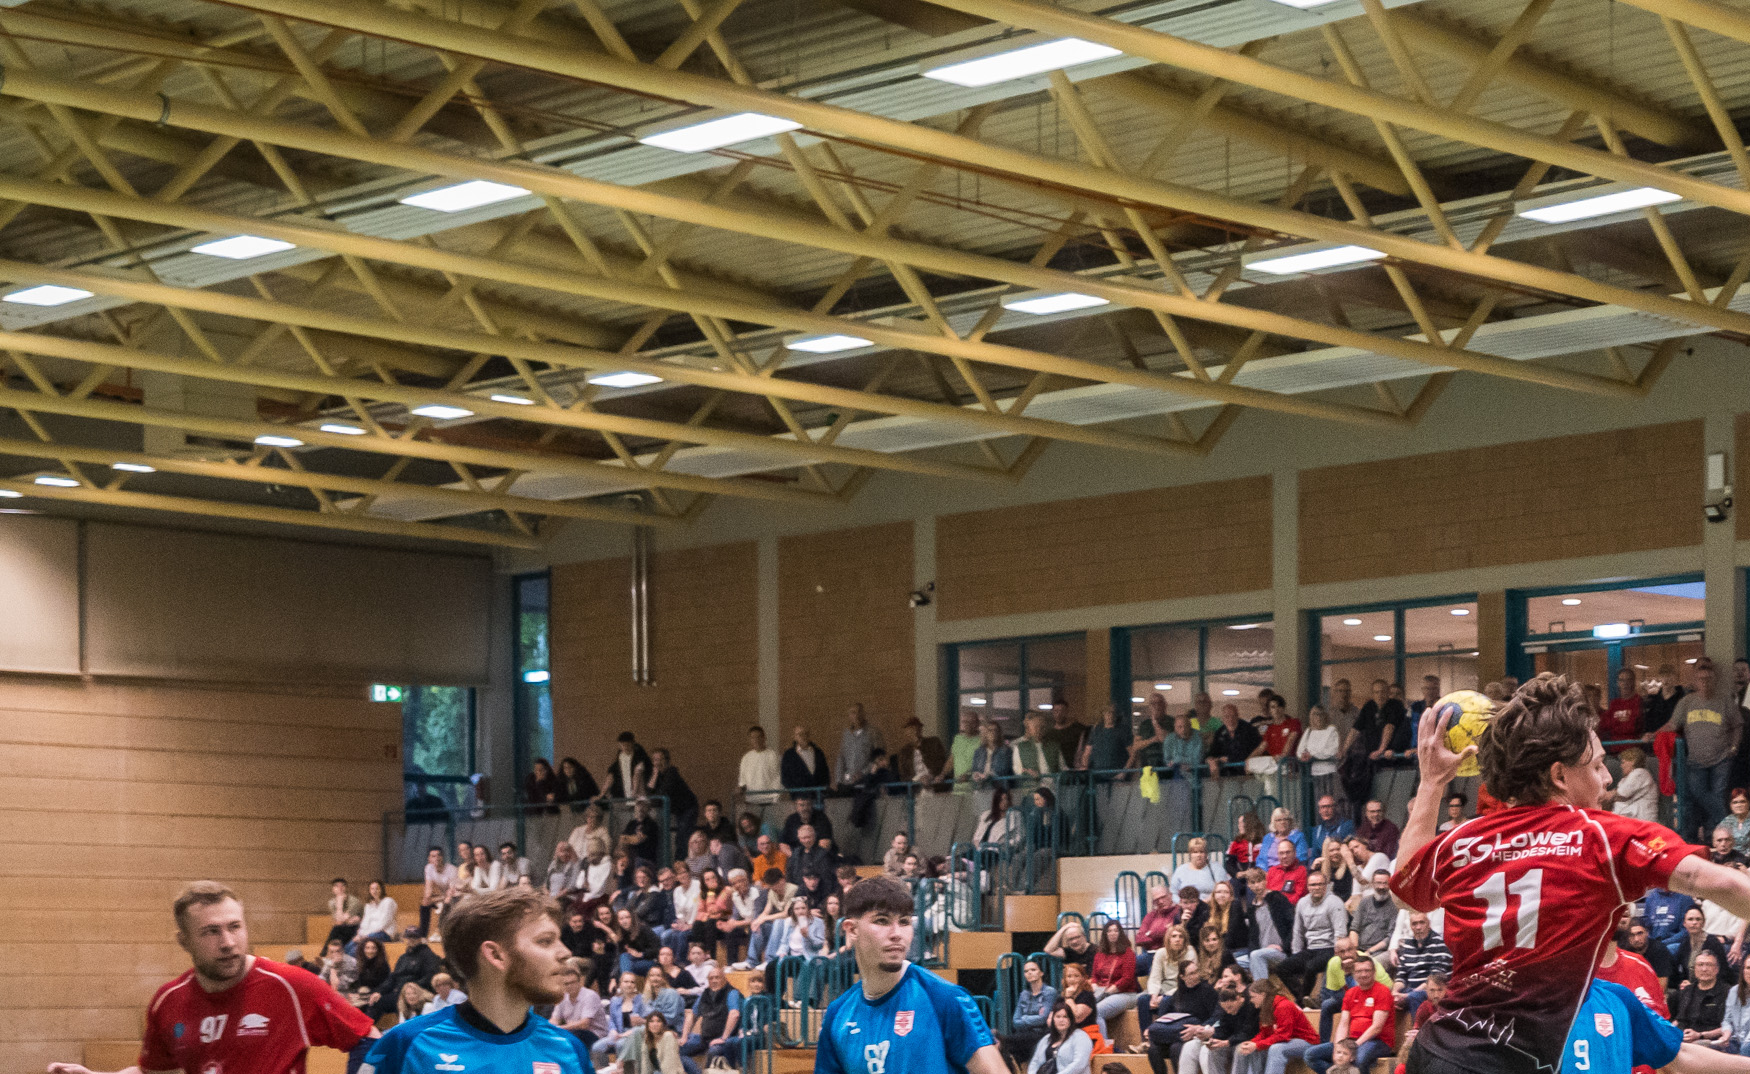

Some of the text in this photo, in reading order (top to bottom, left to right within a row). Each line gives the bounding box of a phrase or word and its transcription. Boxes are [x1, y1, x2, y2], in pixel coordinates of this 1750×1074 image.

[1491, 845, 1583, 862] HEDDESHEIM
[1473, 868, 1544, 951] 11
[199, 1013, 229, 1044] 97
[1573, 1039, 1591, 1071] 9
